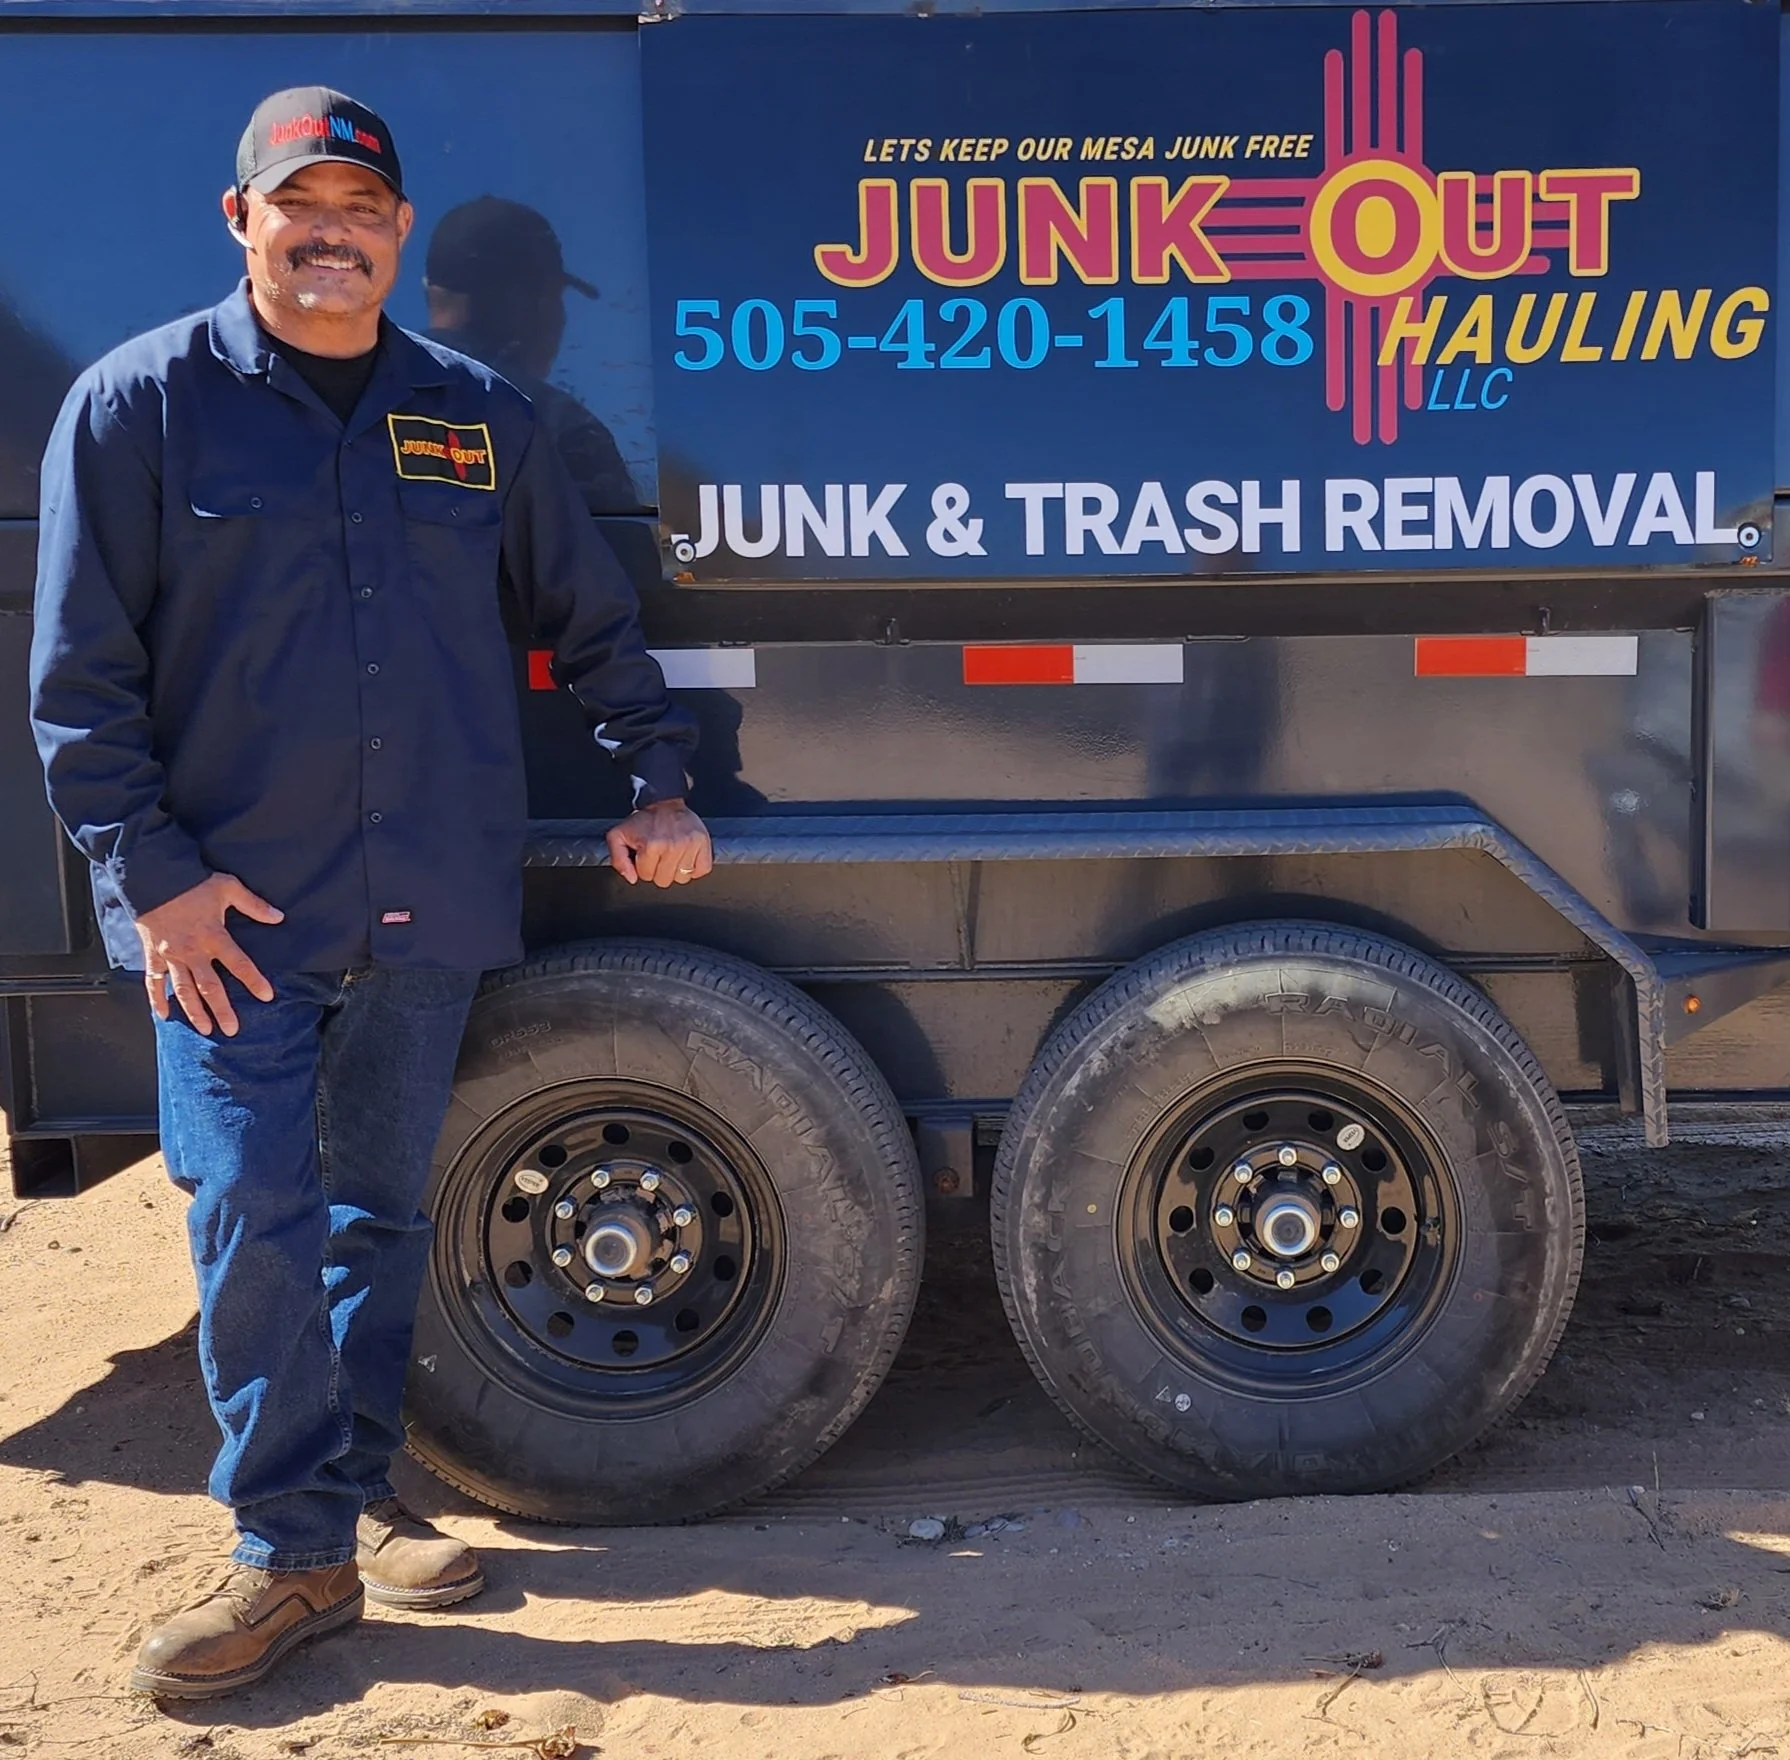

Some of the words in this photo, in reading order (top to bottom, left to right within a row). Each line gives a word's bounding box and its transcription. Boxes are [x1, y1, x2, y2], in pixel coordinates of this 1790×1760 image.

[863, 137, 932, 163] LETS
[938, 137, 1010, 162] KEEP
[1016, 137, 1073, 162] OUR
[1079, 136, 1155, 161] MESA
[1164, 135, 1240, 160] JUNK
[1244, 134, 1314, 159] FREE
[814, 175, 1232, 287] JUNK
[1310, 161, 1640, 294] OUT
[674, 295, 1314, 371] 505-420-1458
[1377, 287, 1770, 366] HAULING
[1427, 367, 1513, 411] LLC
[400, 439, 448, 459] JUNK
[450, 447, 487, 464] OUT
[671, 483, 910, 559] JUNK
[925, 482, 988, 558] &
[1005, 479, 1301, 556] TRASH
[1324, 471, 1739, 553] REMOVAL
[1263, 992, 1480, 1109] RADIAL
